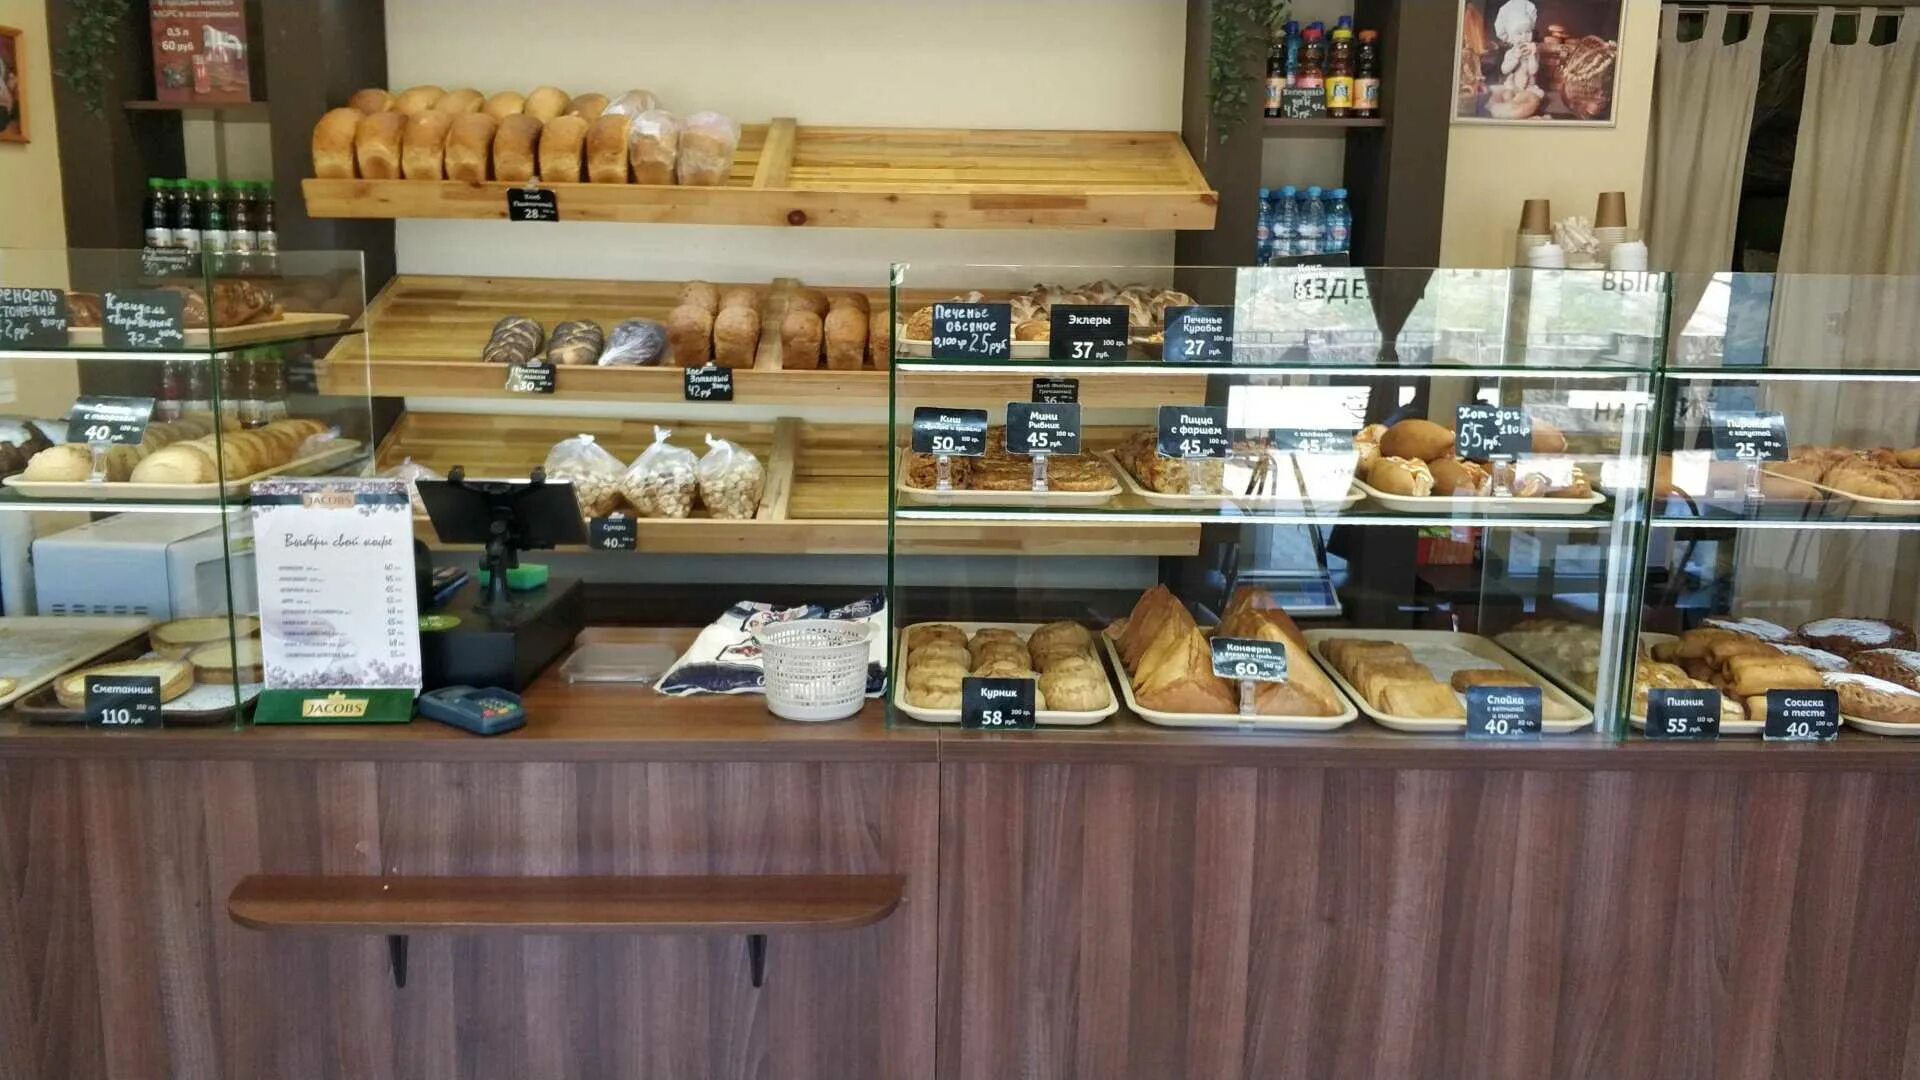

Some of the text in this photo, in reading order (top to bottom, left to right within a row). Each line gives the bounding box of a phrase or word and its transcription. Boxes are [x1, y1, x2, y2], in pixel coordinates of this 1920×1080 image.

[161, 40, 194, 52] 60 руб
[524, 208, 539, 218] 28
[935, 304, 989, 319] Печенье
[1068, 314, 1111, 327] Эклеры
[1183, 315, 1222, 324] Печенье
[1183, 324, 1222, 334] Курабье
[1072, 341, 1094, 358] 37
[1184, 340, 1205, 355] 27
[1095, 351, 1110, 359] руб.
[688, 384, 700, 397] 42
[940, 415, 961, 424] Киш
[1030, 411, 1058, 421] Мини
[1180, 414, 1213, 425] Пицца
[1028, 421, 1060, 429] Рыбник
[1171, 425, 1222, 436] с фаршем
[84, 425, 111, 440] 40
[1460, 423, 1482, 447] 55
[932, 436, 954, 450] 50
[1027, 432, 1048, 447] 45
[1180, 439, 1201, 455] 45
[1735, 442, 1756, 457] 25
[603, 537, 618, 548] 40
[1226, 644, 1272, 654] Конверт
[1235, 662, 1258, 675] 60
[92, 684, 154, 694] Сметанник
[981, 687, 1017, 700] Курник
[1486, 695, 1524, 705] Слойка
[1667, 697, 1704, 706] Пикник
[1784, 698, 1824, 707] Сосиска
[307, 702, 364, 715] JACOBS
[1791, 709, 1826, 718] тесте
[101, 709, 130, 724] 110
[982, 710, 1003, 725] 58
[1485, 719, 1508, 734] 40
[1666, 718, 1688, 733] 55
[1786, 722, 1809, 737] 40
